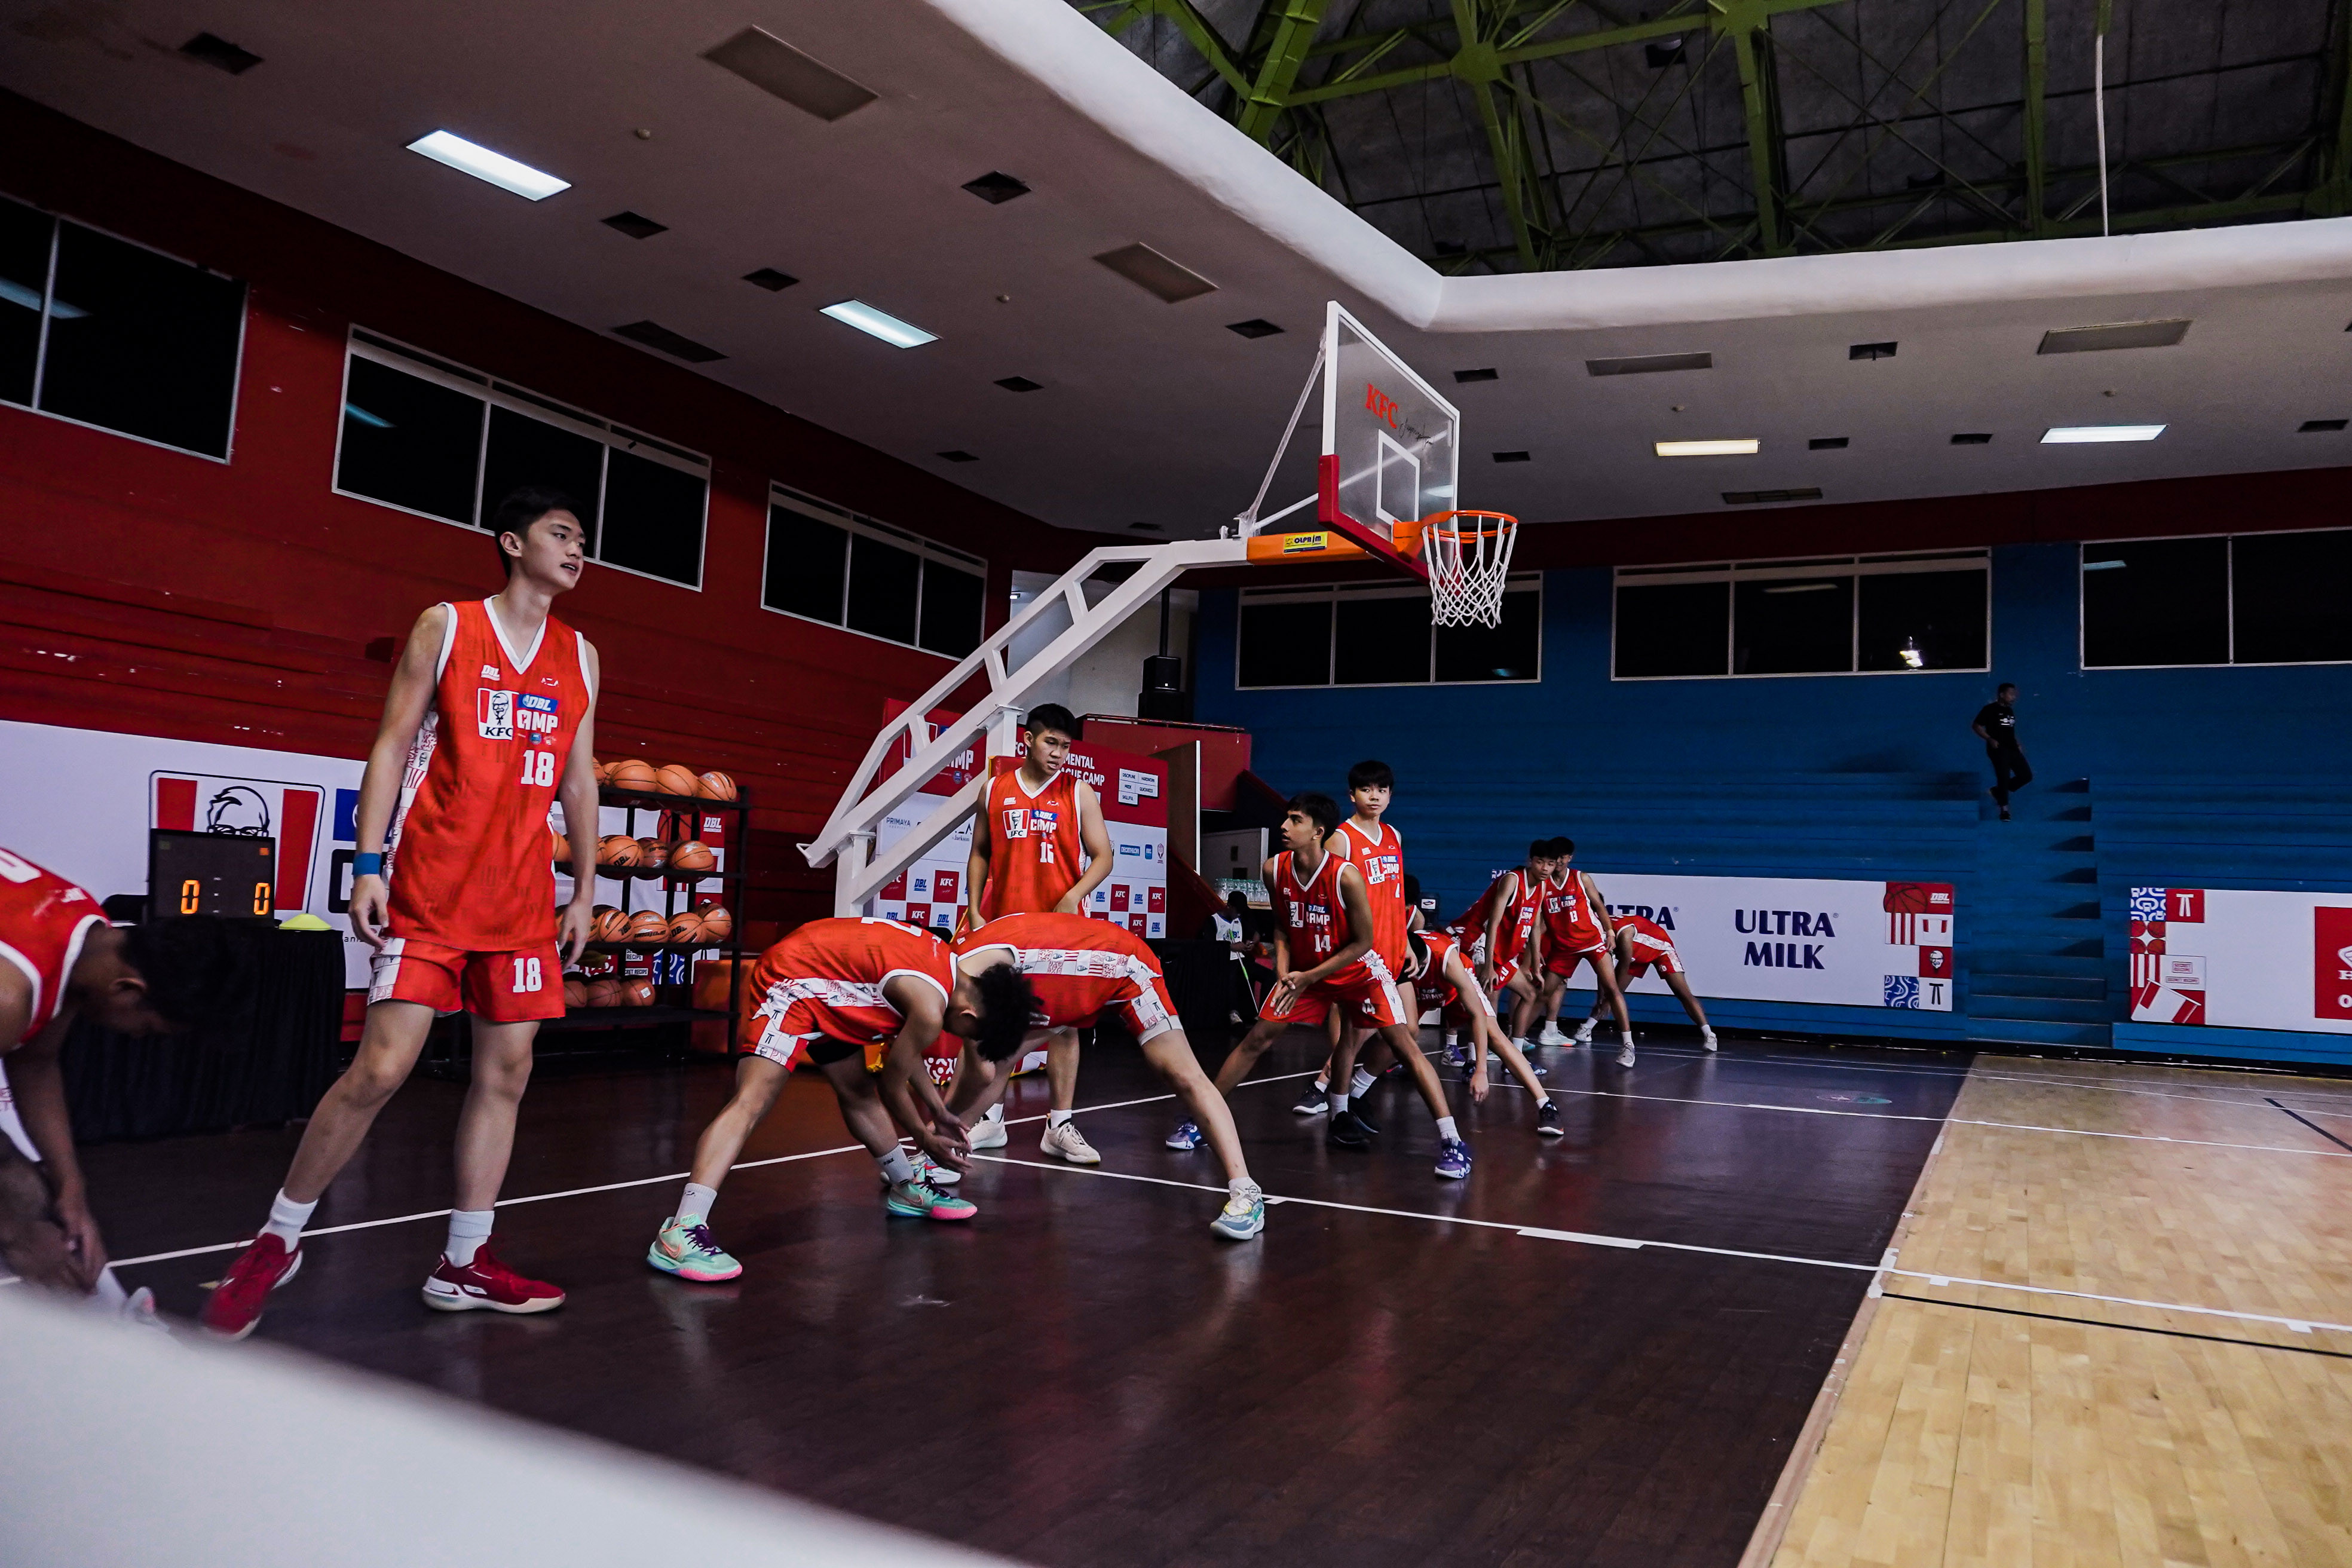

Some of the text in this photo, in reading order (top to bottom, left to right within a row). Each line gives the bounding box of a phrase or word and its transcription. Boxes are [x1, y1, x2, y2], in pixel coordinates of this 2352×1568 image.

[1365, 383, 1398, 429] KFC
[528, 696, 551, 712] DBL
[520, 749, 555, 787] 18
[1083, 771, 1105, 786] CAMP
[703, 817, 721, 828] DBL
[886, 817, 911, 826] PRIMAYA
[1030, 819, 1057, 834] CAMP
[914, 878, 927, 888] DBL
[939, 878, 954, 886] KFC
[181, 880, 200, 914] 0
[253, 882, 271, 915] 0
[1096, 891, 1105, 899] DBL
[1930, 893, 1950, 901] DBL
[886, 912, 899, 921] DBL
[911, 910, 926, 919] KFC
[937, 914, 950, 923] DBL
[1735, 909, 1836, 937] ULTRA
[1315, 934, 1331, 953] 14
[1744, 941, 1826, 970] MILK
[513, 957, 542, 993] 18
